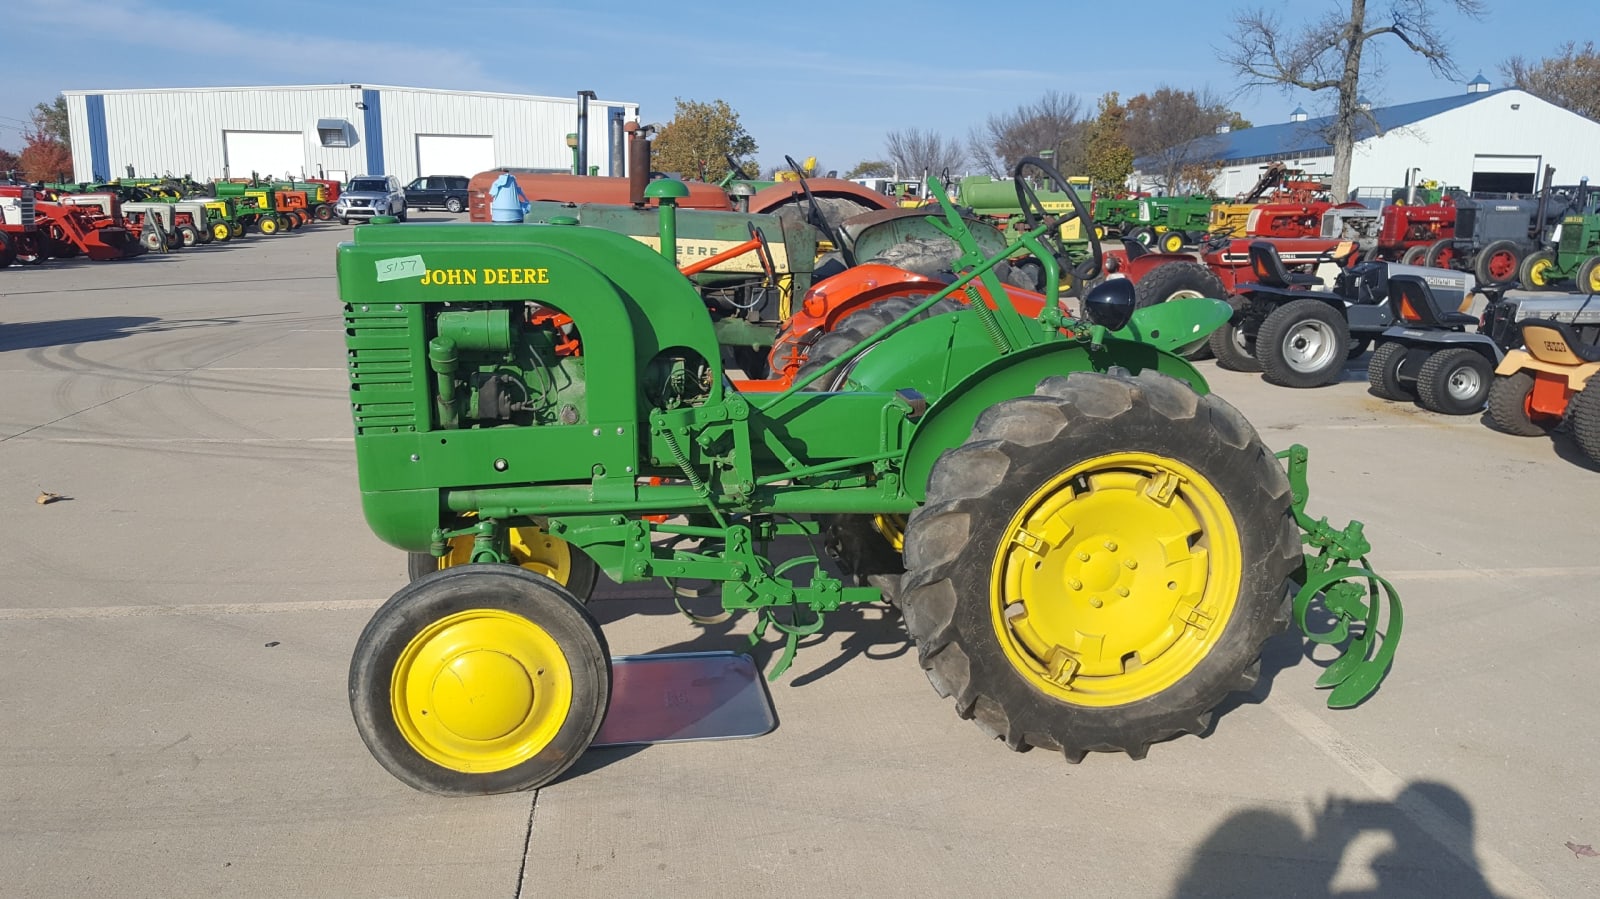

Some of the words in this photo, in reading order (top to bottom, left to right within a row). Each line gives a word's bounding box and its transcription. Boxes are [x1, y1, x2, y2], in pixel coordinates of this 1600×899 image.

[676, 245, 719, 256] EERE
[420, 269, 477, 285] JOHN
[483, 268, 549, 284] DEERE
